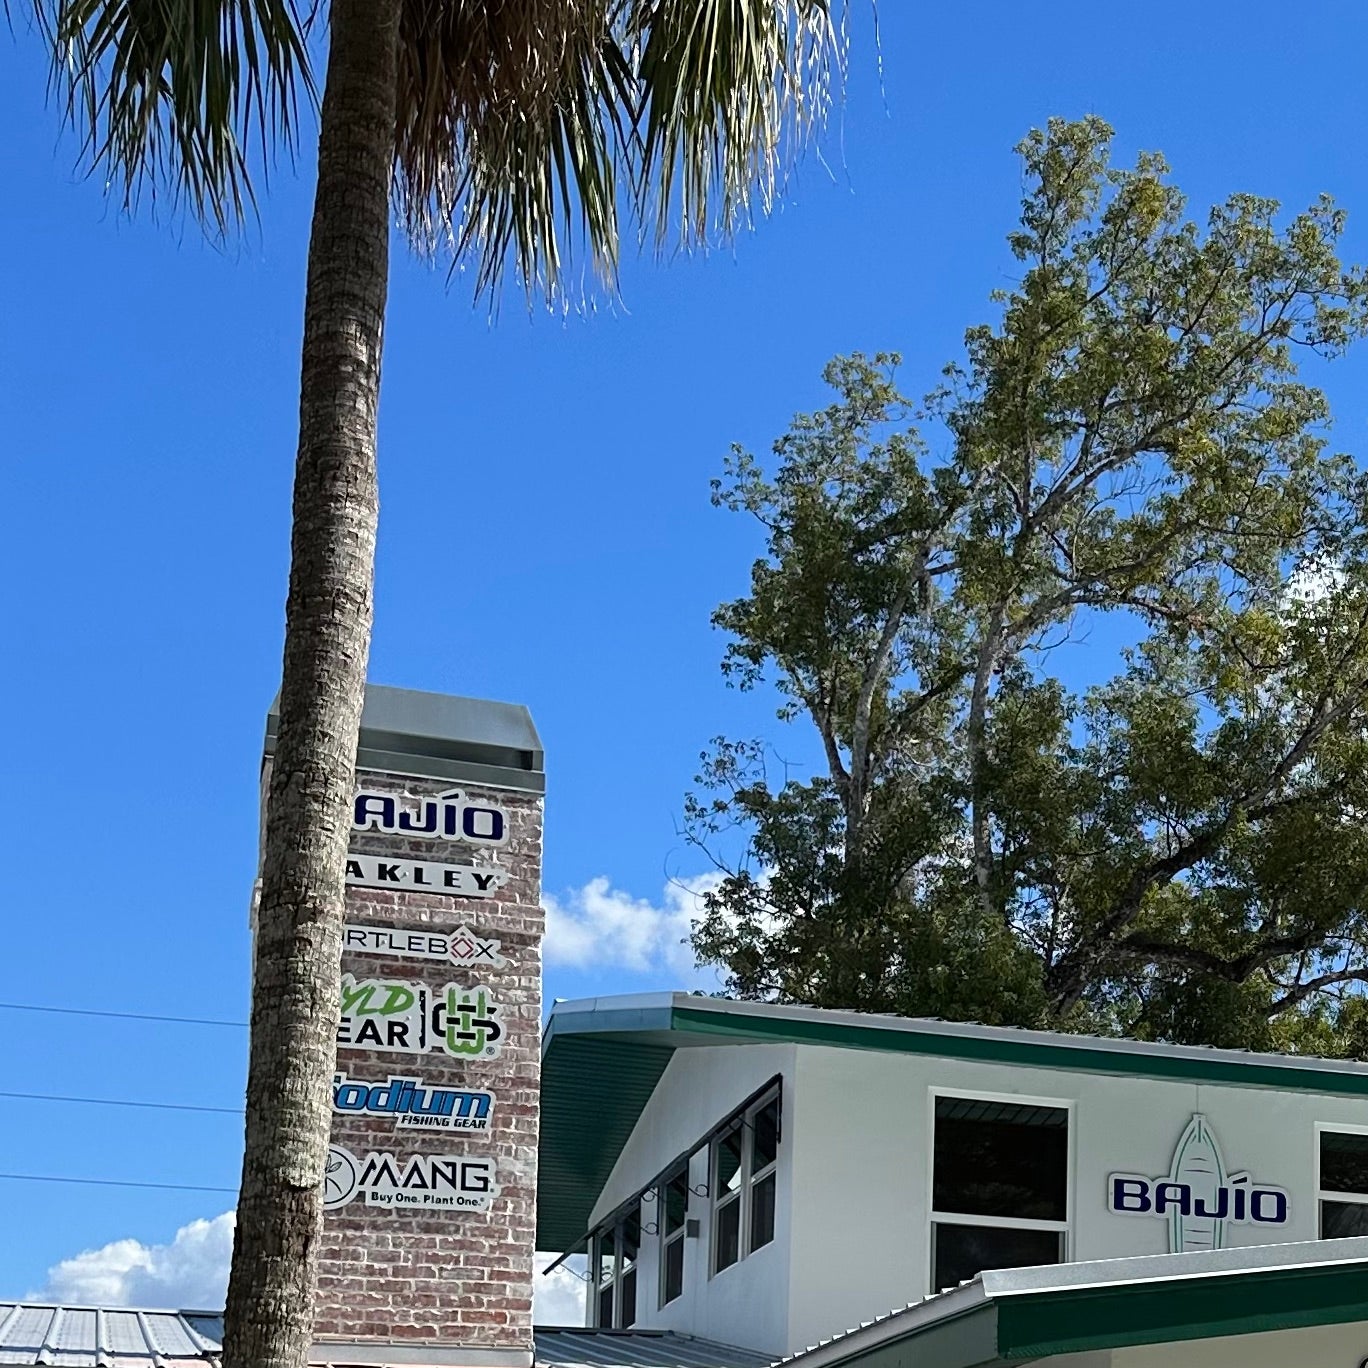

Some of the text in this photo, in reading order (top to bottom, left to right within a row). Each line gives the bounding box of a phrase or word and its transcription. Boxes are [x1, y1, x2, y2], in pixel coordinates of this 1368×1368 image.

[354, 793, 503, 840] AJÍO
[345, 860, 495, 891] AKLEY
[342, 930, 494, 959] RTLEBOX
[342, 984, 415, 1016] YLD
[337, 1016, 410, 1048] EAR
[332, 1080, 491, 1118] odium
[401, 1115, 486, 1129] FISHING GEAR
[371, 1192, 393, 1203] Buy
[423, 1194, 454, 1205] Plant
[1113, 1176, 1287, 1223] BAJÍO
